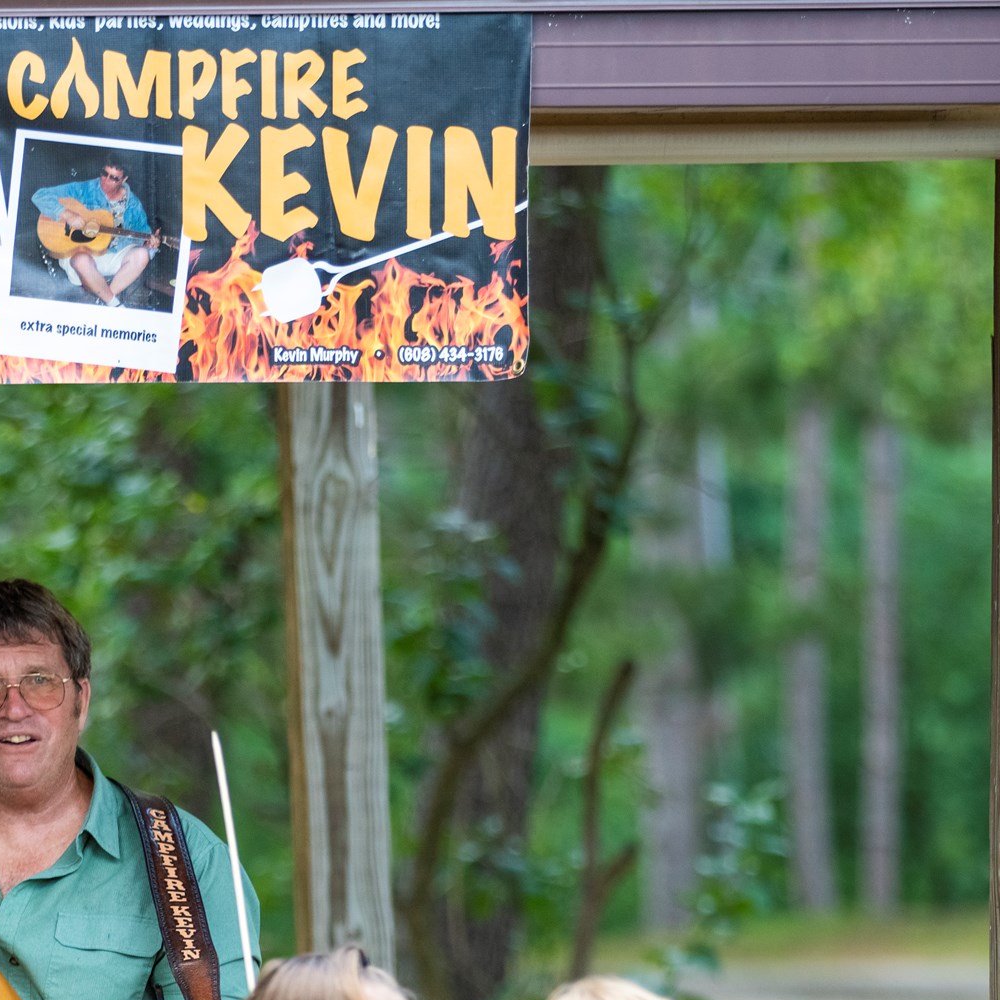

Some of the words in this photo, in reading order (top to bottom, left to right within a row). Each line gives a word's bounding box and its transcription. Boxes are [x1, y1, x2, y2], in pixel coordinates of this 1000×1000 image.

[353, 14, 386, 29] and
[391, 13, 442, 29] more!
[6, 36, 369, 121] CAMPFIRE
[182, 122, 518, 242] KEVIN
[20, 320, 53, 333] extra
[56, 324, 98, 337] special
[100, 328, 157, 343] memories
[273, 346, 308, 363] Kevin
[309, 346, 360, 365] Murphy
[398, 346, 437, 363] (608)
[438, 346, 504, 363] 434-3176
[149, 808, 188, 903] CAMPFIRE
[170, 905, 201, 961] KEVIN
